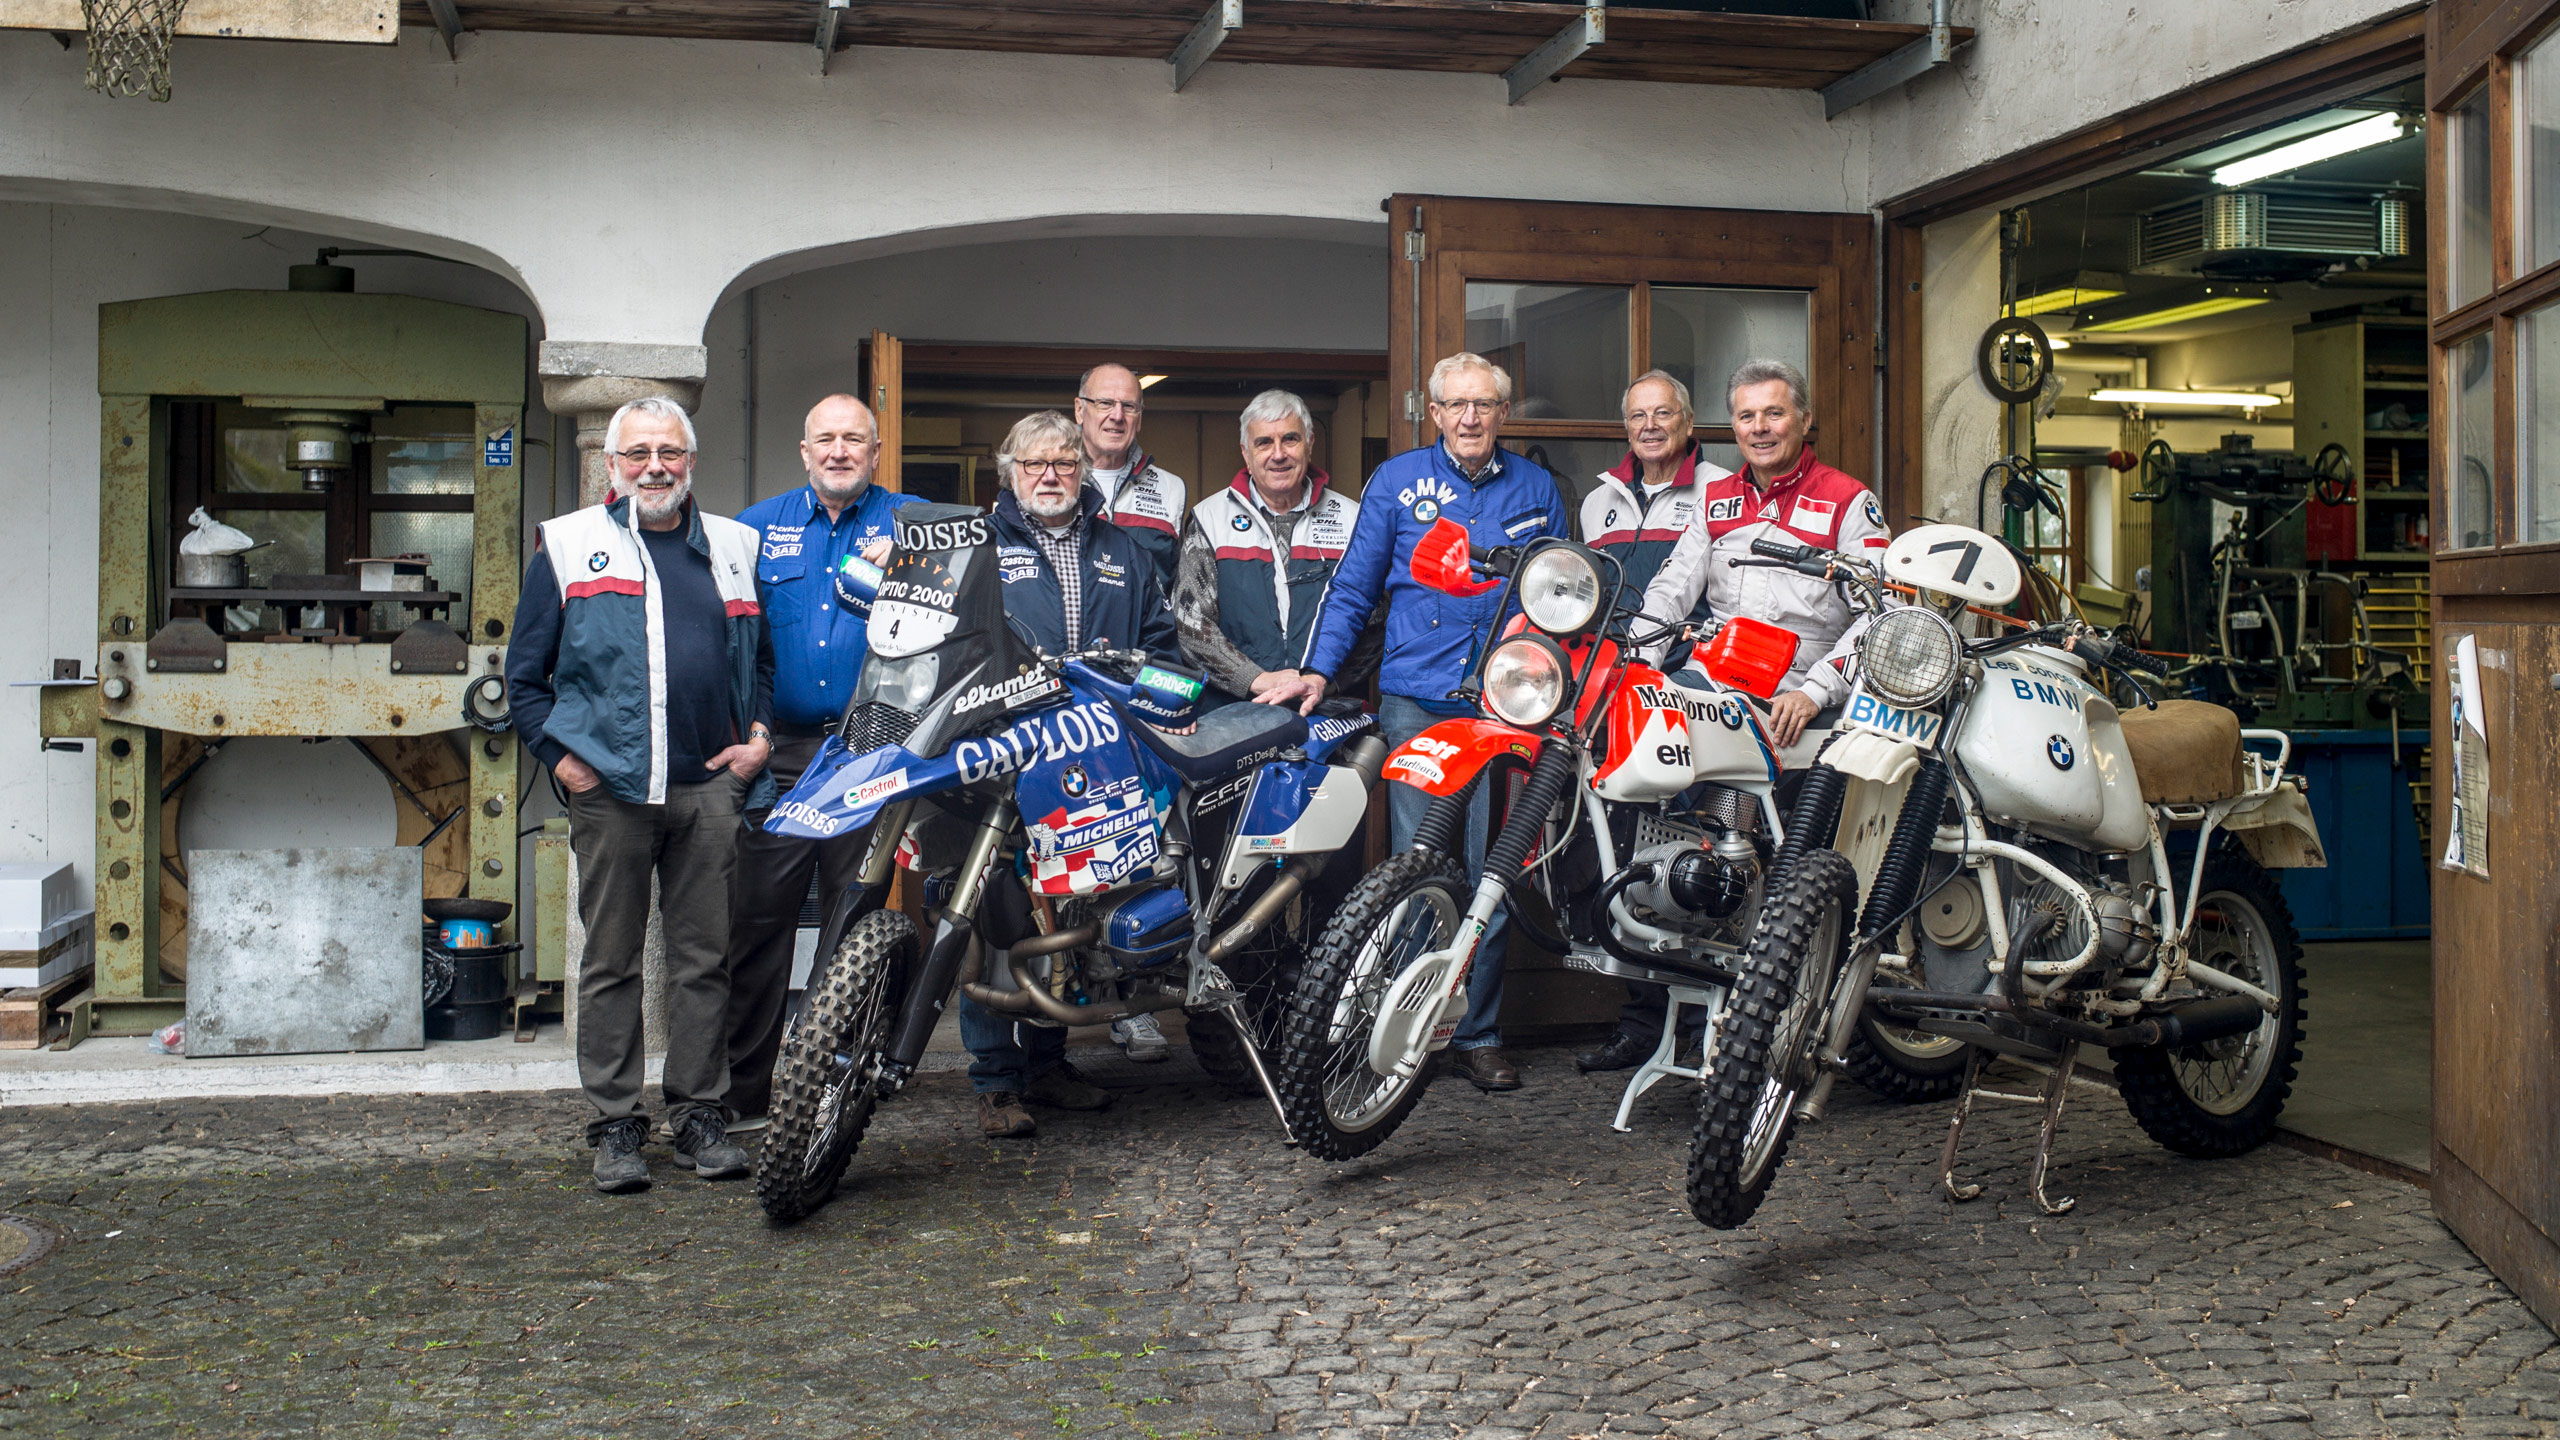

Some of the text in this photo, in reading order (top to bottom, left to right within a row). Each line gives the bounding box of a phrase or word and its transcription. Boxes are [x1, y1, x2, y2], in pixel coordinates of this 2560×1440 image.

[1137, 486, 1157, 494] DHL
[1398, 478, 1457, 507] BMW
[1710, 497, 1742, 518] elf
[767, 531, 802, 543] Castrol
[771, 546, 799, 557] GAS
[1000, 556, 1035, 566] Castrol
[1008, 568, 1035, 581] GAS
[877, 581, 954, 608] OPTIC 2000
[874, 602, 945, 623] TUNISIE
[889, 618, 901, 639] 4
[1983, 658, 2020, 671] Les
[953, 661, 1047, 715] elkamet
[2011, 678, 2080, 713] BMW
[1849, 694, 1940, 742] BMW
[1236, 745, 1278, 769] DTS Design
[1410, 736, 1462, 760] elf
[1656, 744, 1691, 767] elf
[1395, 757, 1438, 778] Marlboro
[860, 776, 898, 800] Castrol
[1063, 806, 1149, 849] MICHELIN
[1111, 839, 1154, 881] GAS
[963, 888, 977, 916] racing
